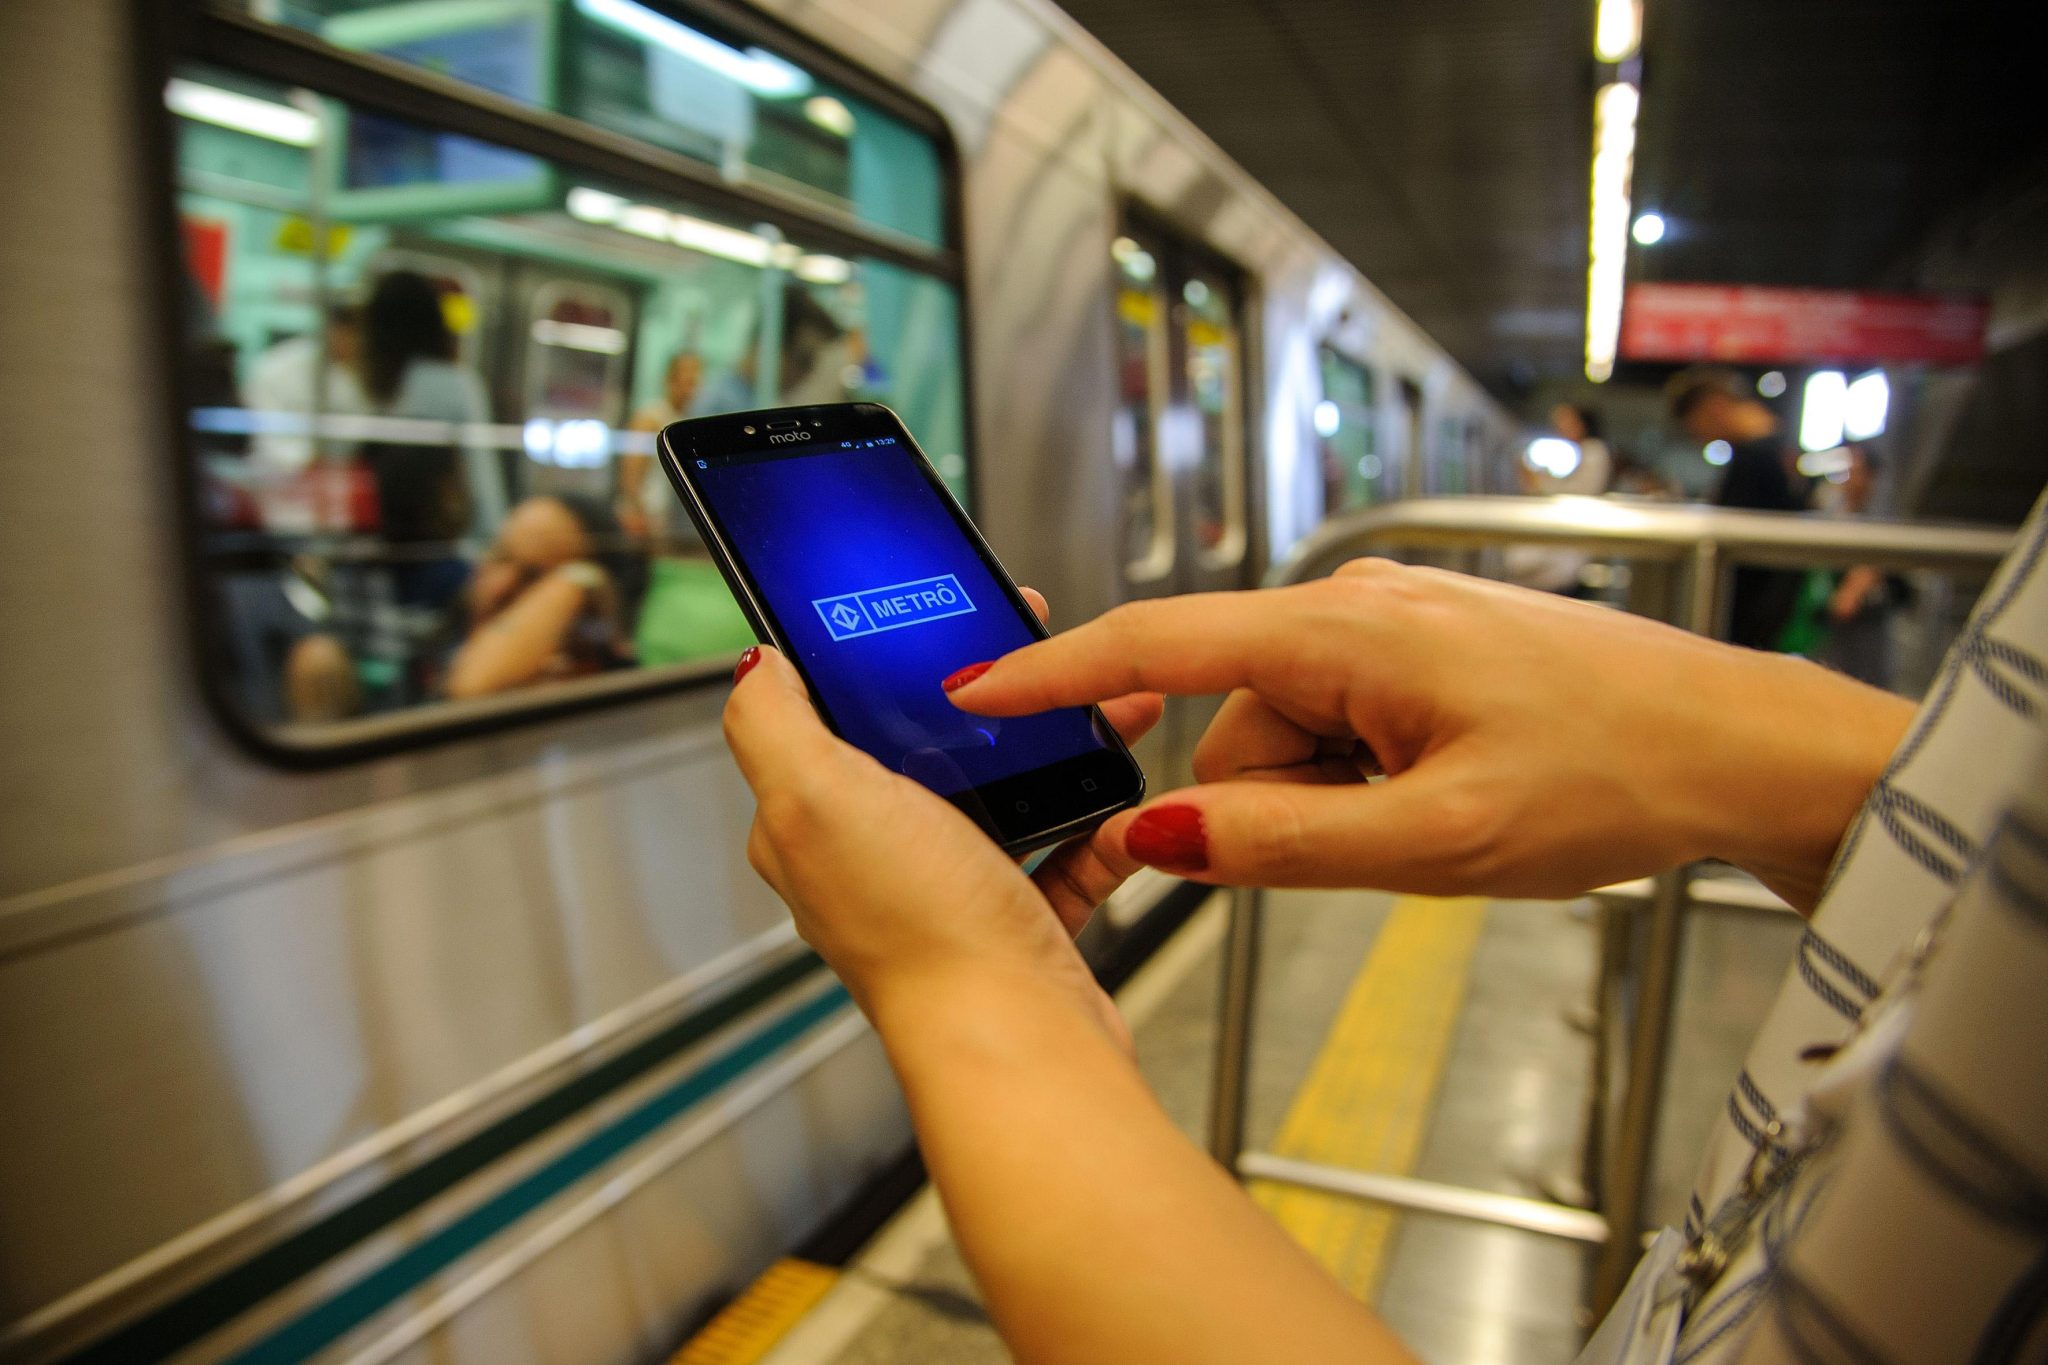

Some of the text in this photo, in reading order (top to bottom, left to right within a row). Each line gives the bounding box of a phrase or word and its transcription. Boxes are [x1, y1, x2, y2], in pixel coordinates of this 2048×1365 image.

[769, 430, 811, 444] moto
[874, 437, 896, 446] 13:29
[870, 583, 957, 619] METRÔ
